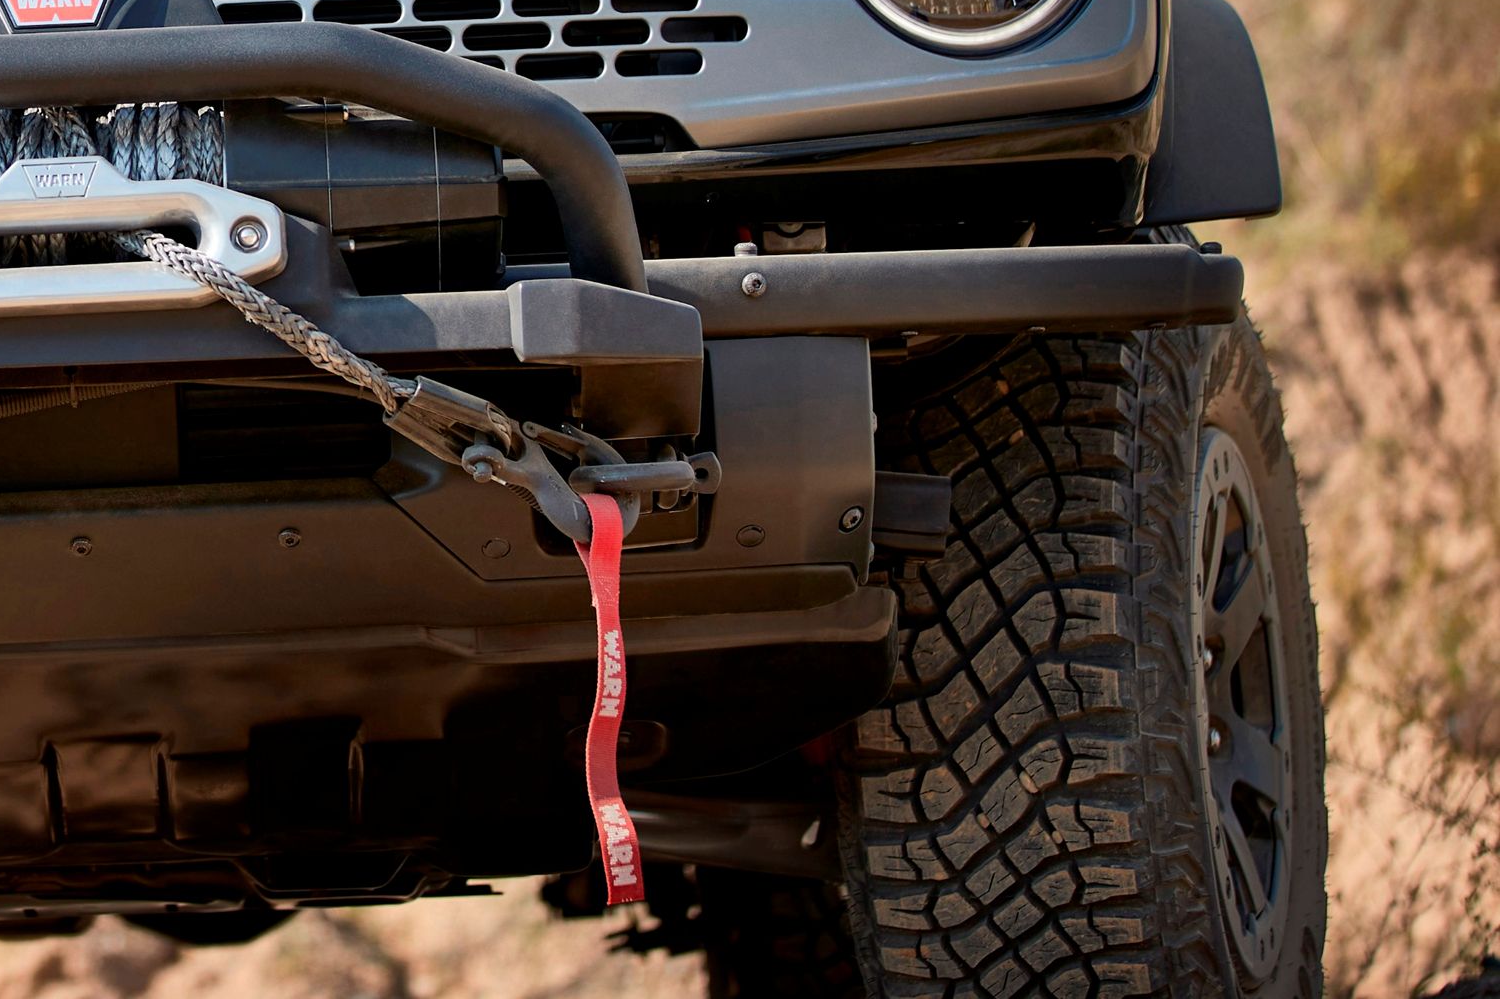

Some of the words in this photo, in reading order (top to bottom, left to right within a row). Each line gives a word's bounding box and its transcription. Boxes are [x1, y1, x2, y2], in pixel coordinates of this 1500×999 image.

[35, 172, 85, 188] WARN
[598, 629, 623, 718] WARN
[598, 803, 638, 887] WARN
